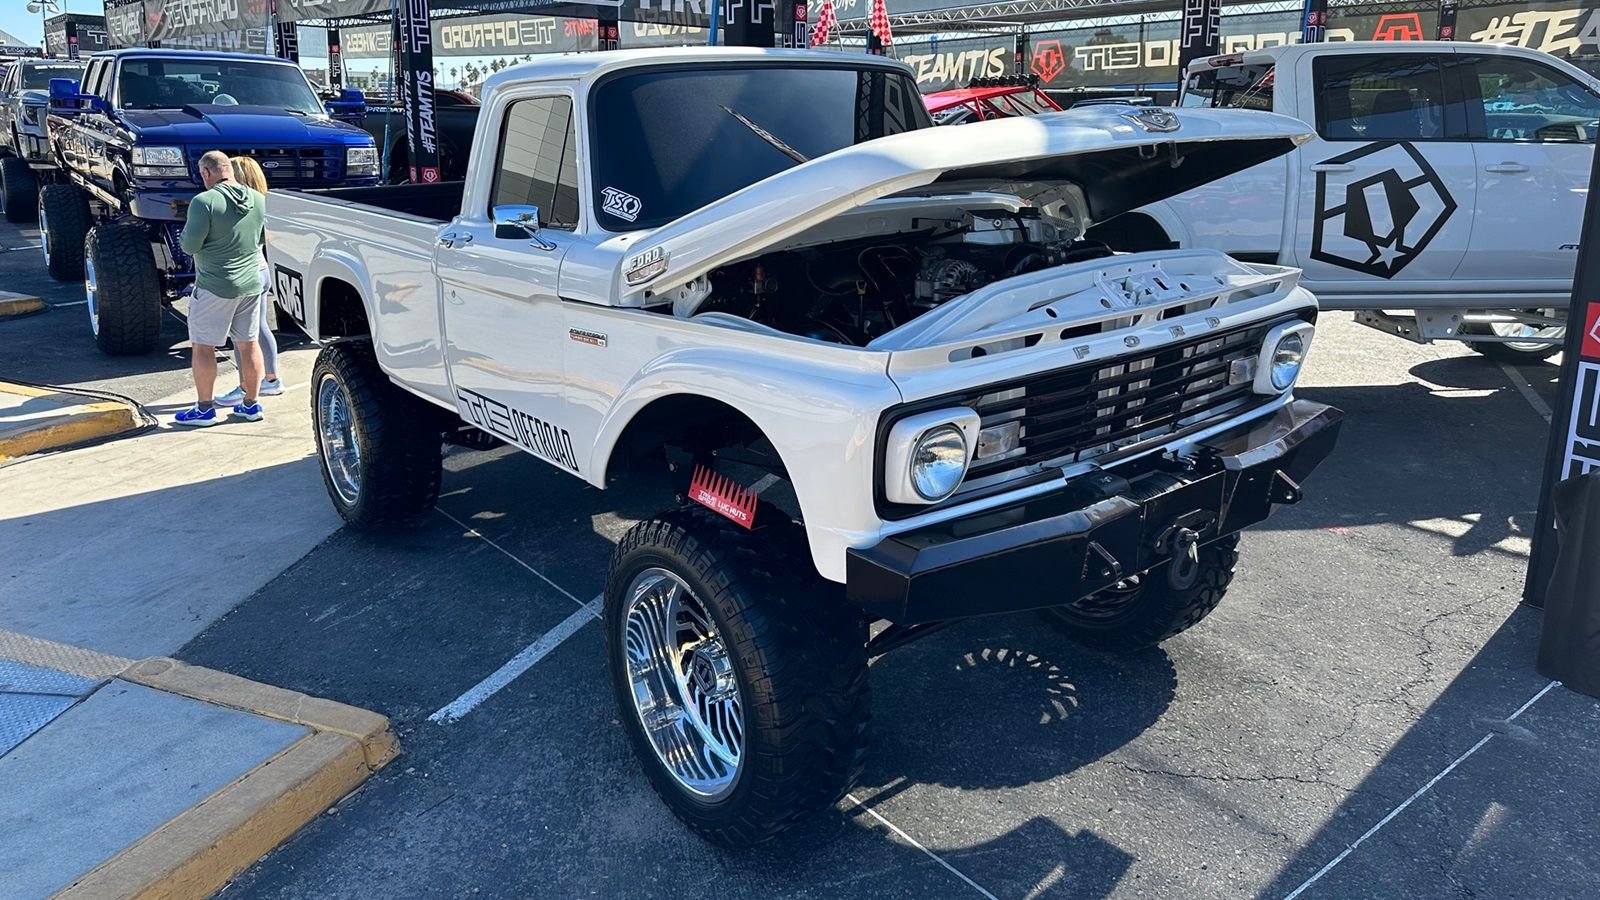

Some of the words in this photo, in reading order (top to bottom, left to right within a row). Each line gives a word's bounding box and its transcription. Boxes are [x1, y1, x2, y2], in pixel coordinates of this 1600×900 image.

[896, 46, 1006, 84] TEAMTIS
[1075, 42, 1142, 71] TIS
[416, 70, 437, 154] #TEAMTIS
[631, 247, 661, 272] FORD
[1072, 316, 1221, 361] FORD
[456, 387, 519, 442] TIS
[511, 408, 580, 472] OFFROAD
[729, 507, 747, 521] NUTS
